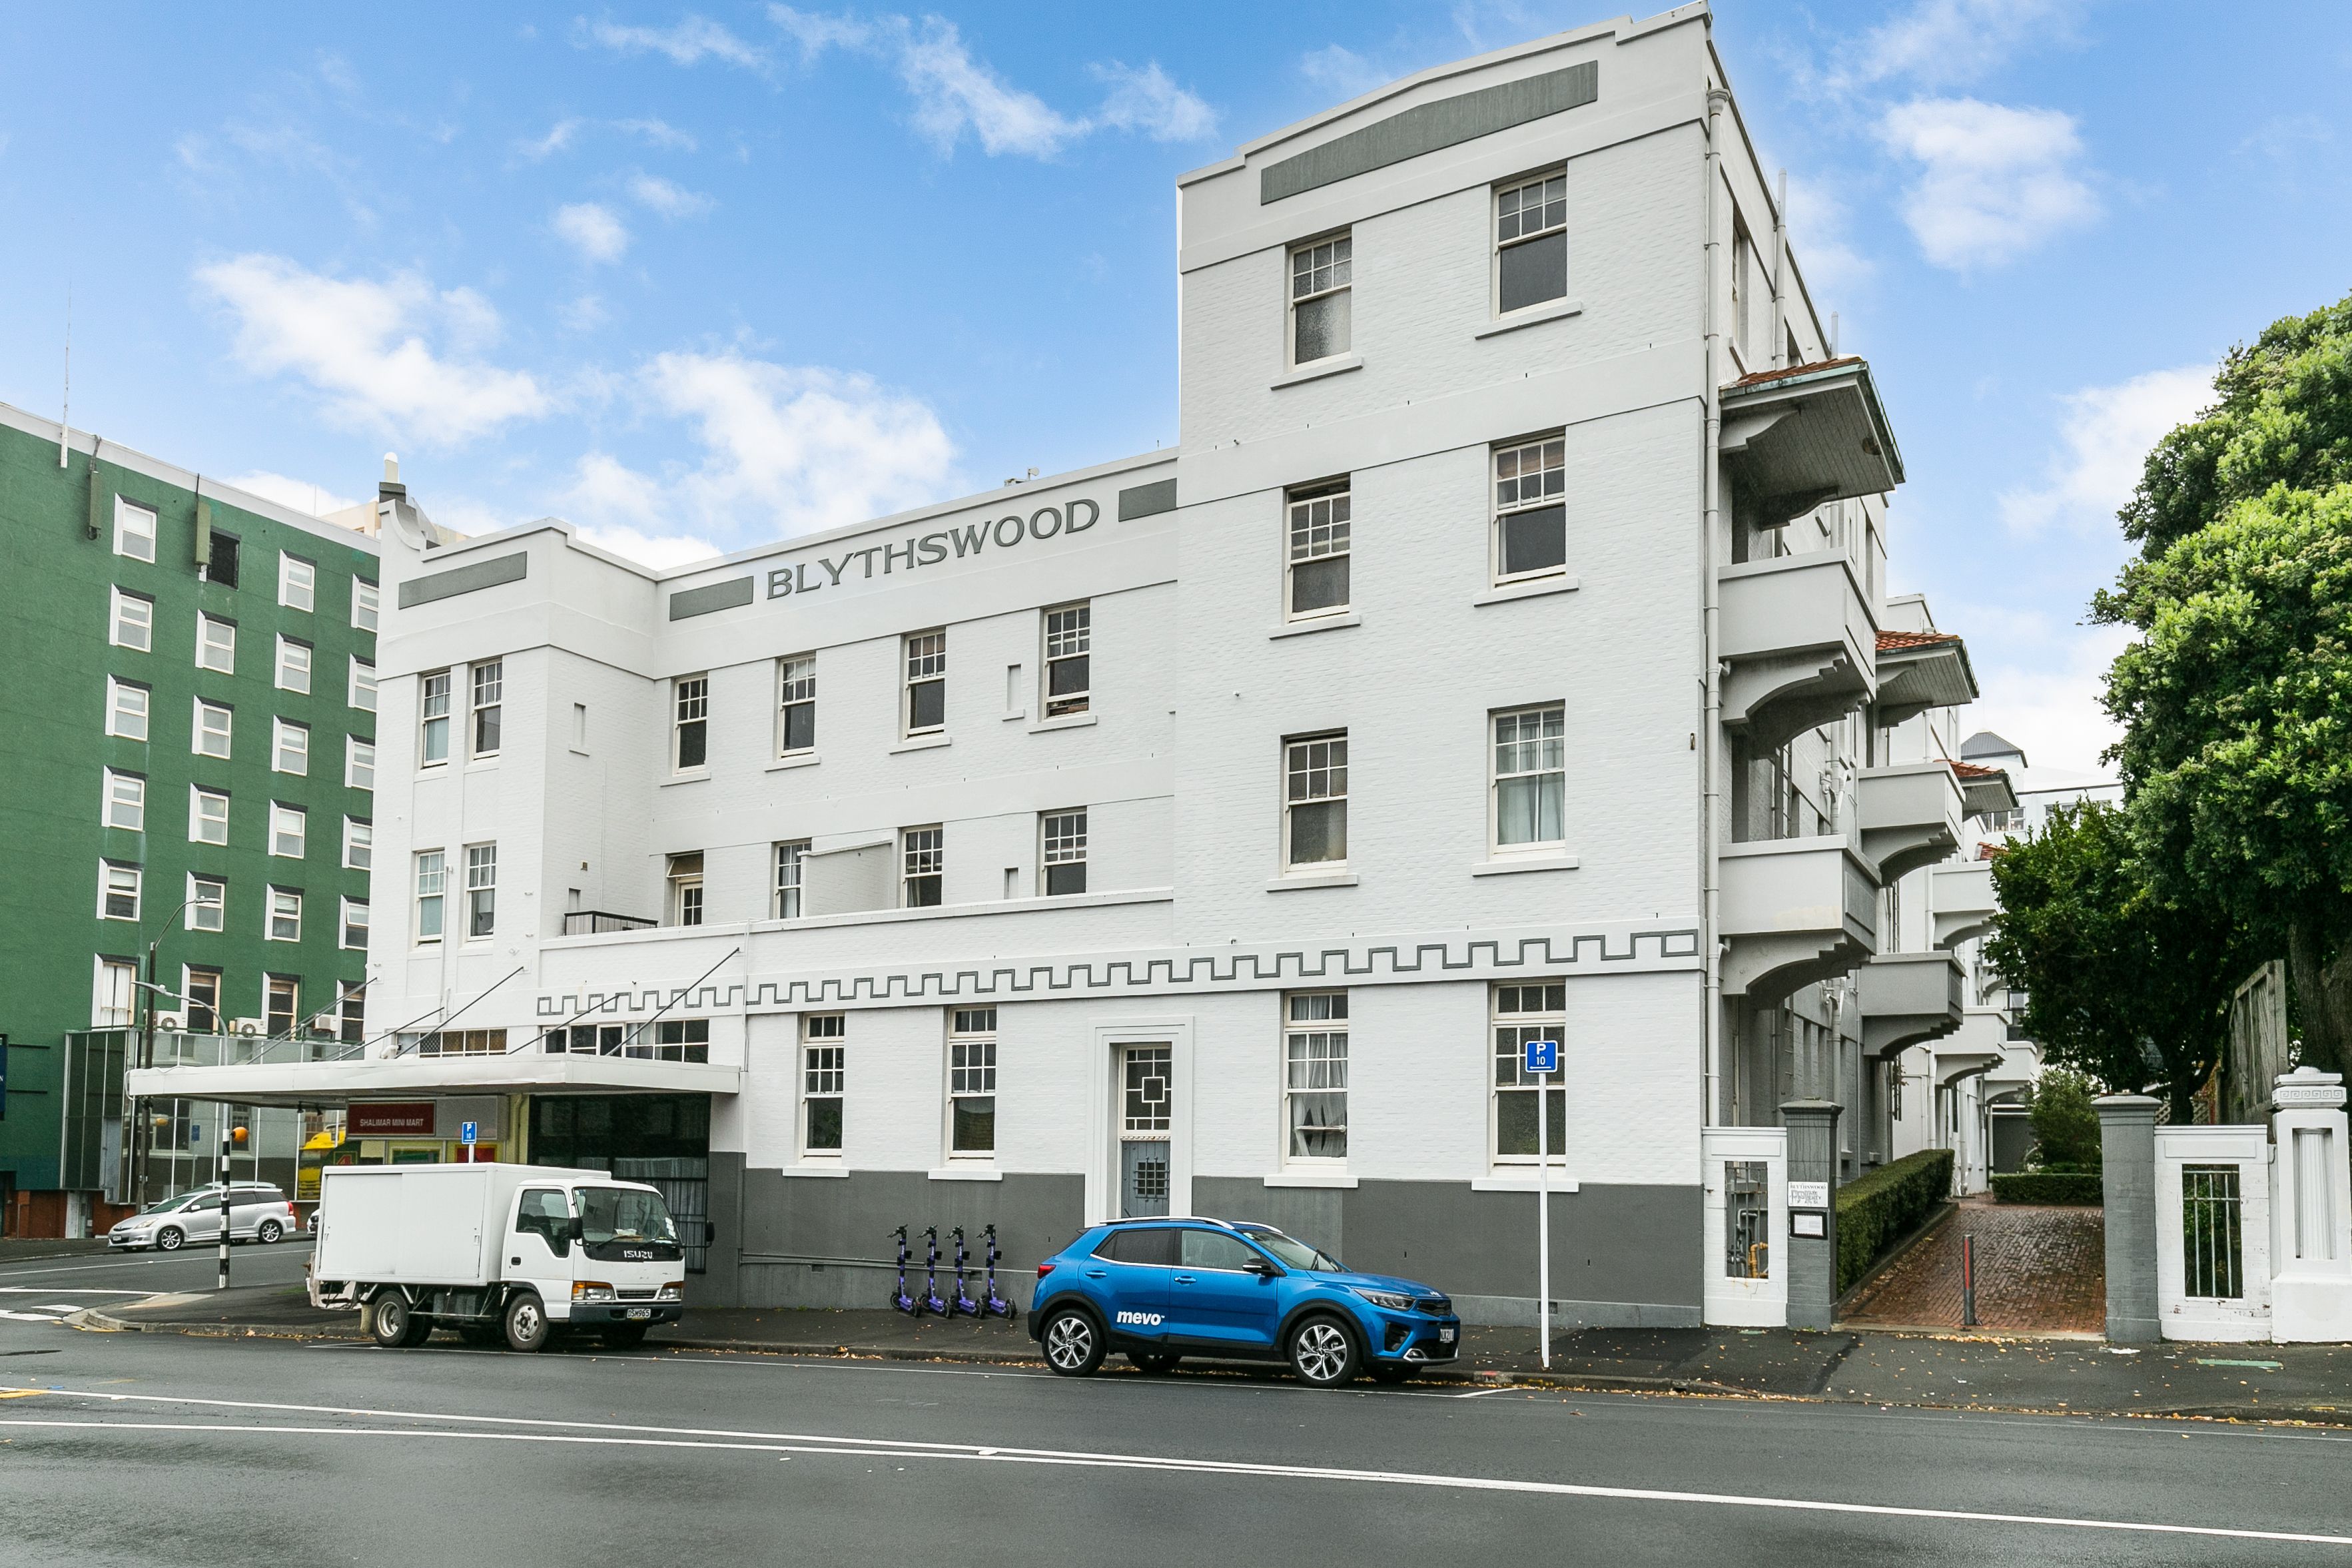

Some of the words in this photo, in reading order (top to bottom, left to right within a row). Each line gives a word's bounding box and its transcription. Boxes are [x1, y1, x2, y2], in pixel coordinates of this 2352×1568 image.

[766, 498, 1100, 599] BLYTHSWOOD
[1537, 1043, 1546, 1054] P
[1537, 1056, 1545, 1065] 10
[467, 1123, 472, 1132] P
[623, 1250, 653, 1259] ISUZU
[1116, 1311, 1161, 1326] mevo
